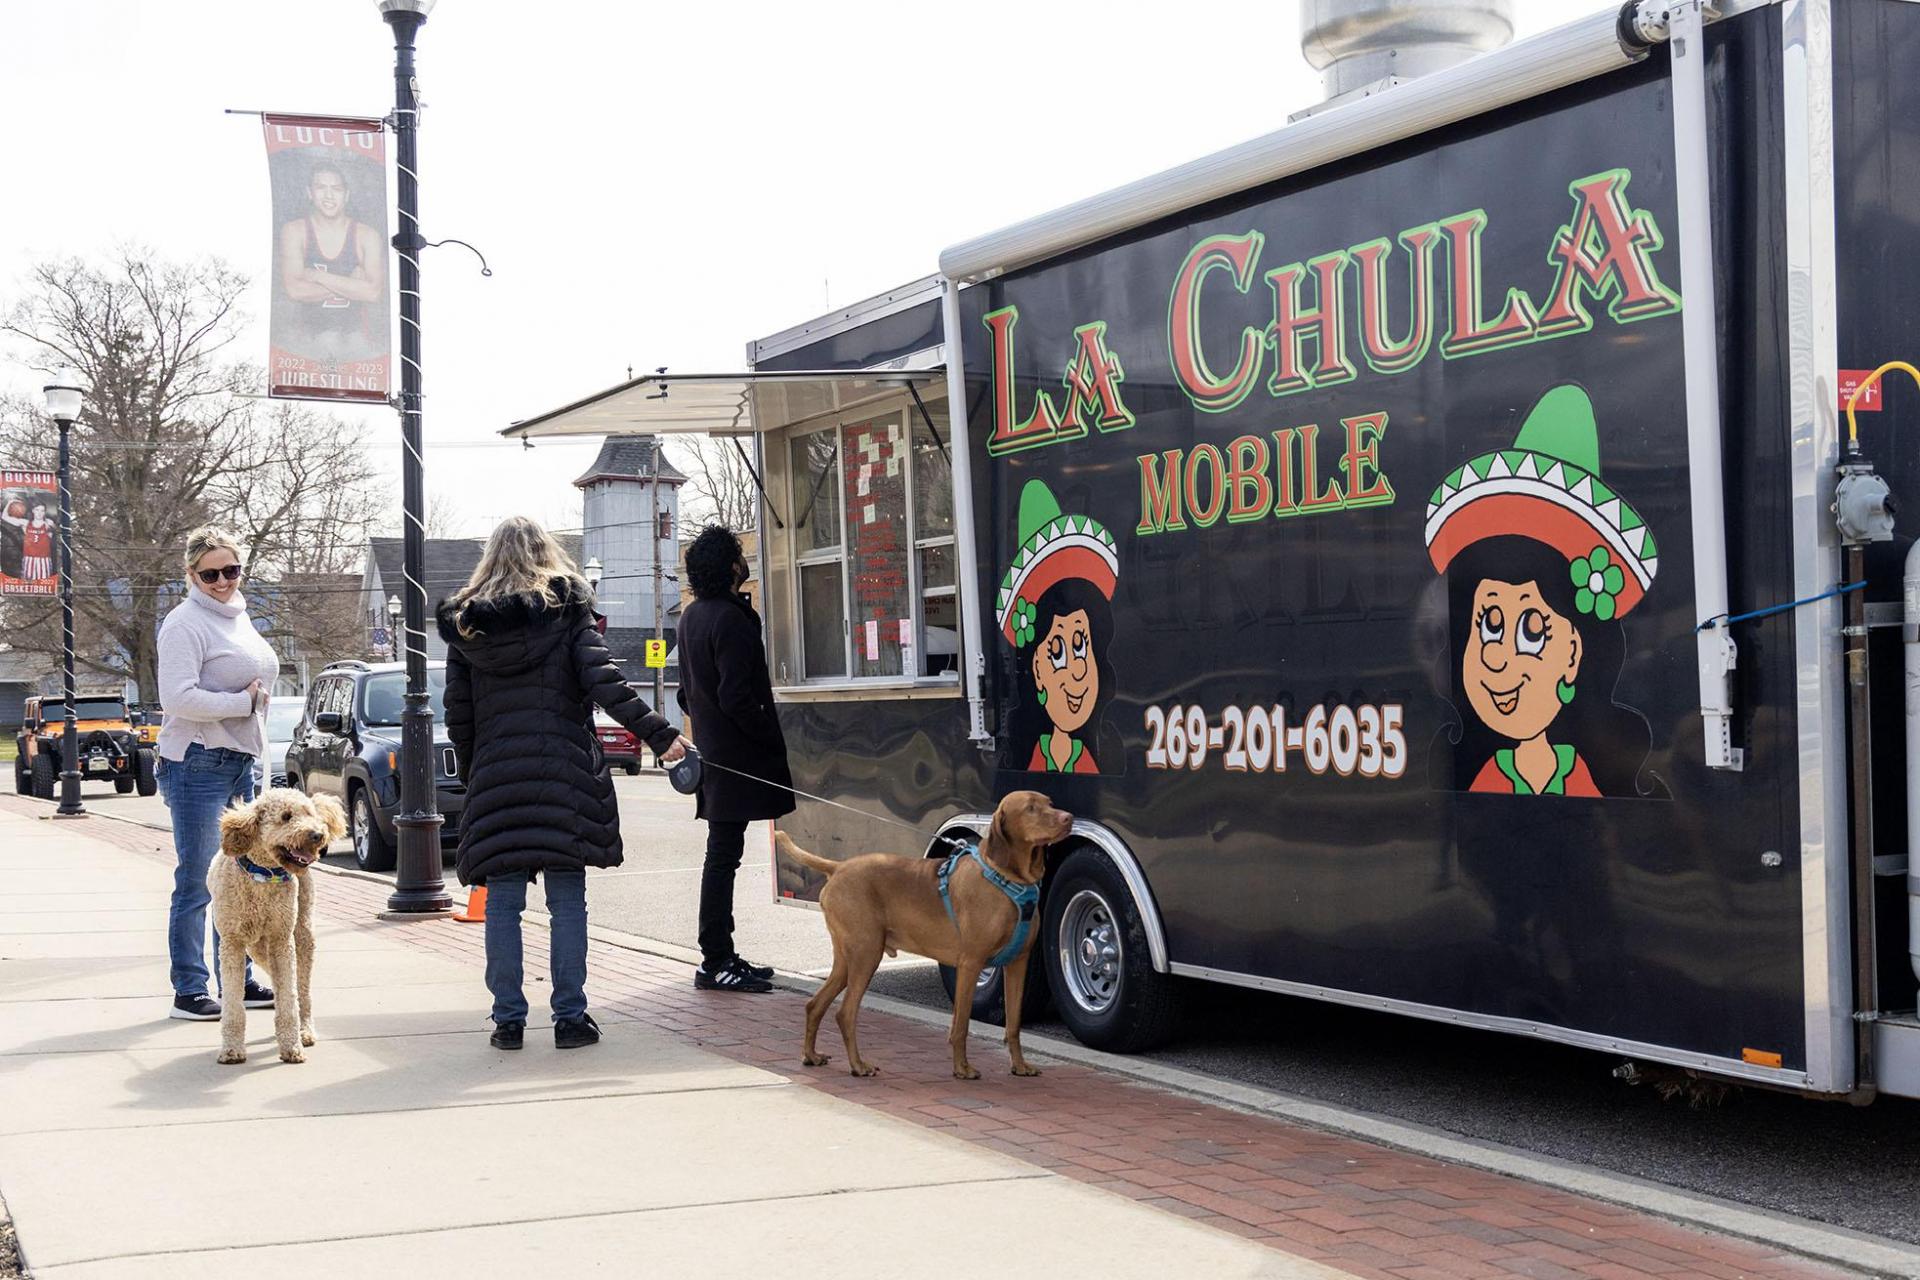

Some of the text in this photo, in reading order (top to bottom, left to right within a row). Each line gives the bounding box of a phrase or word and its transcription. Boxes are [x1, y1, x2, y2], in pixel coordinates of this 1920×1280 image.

[983, 167, 1684, 457] LA CHULA
[278, 357, 305, 369] 2022
[355, 363, 384, 375] 2023
[281, 371, 377, 391] WRESTLING
[1136, 411, 1397, 535] MOBILE
[4, 584, 53, 594] BASKETBALL
[1144, 703, 1408, 779] 269-201-6035
